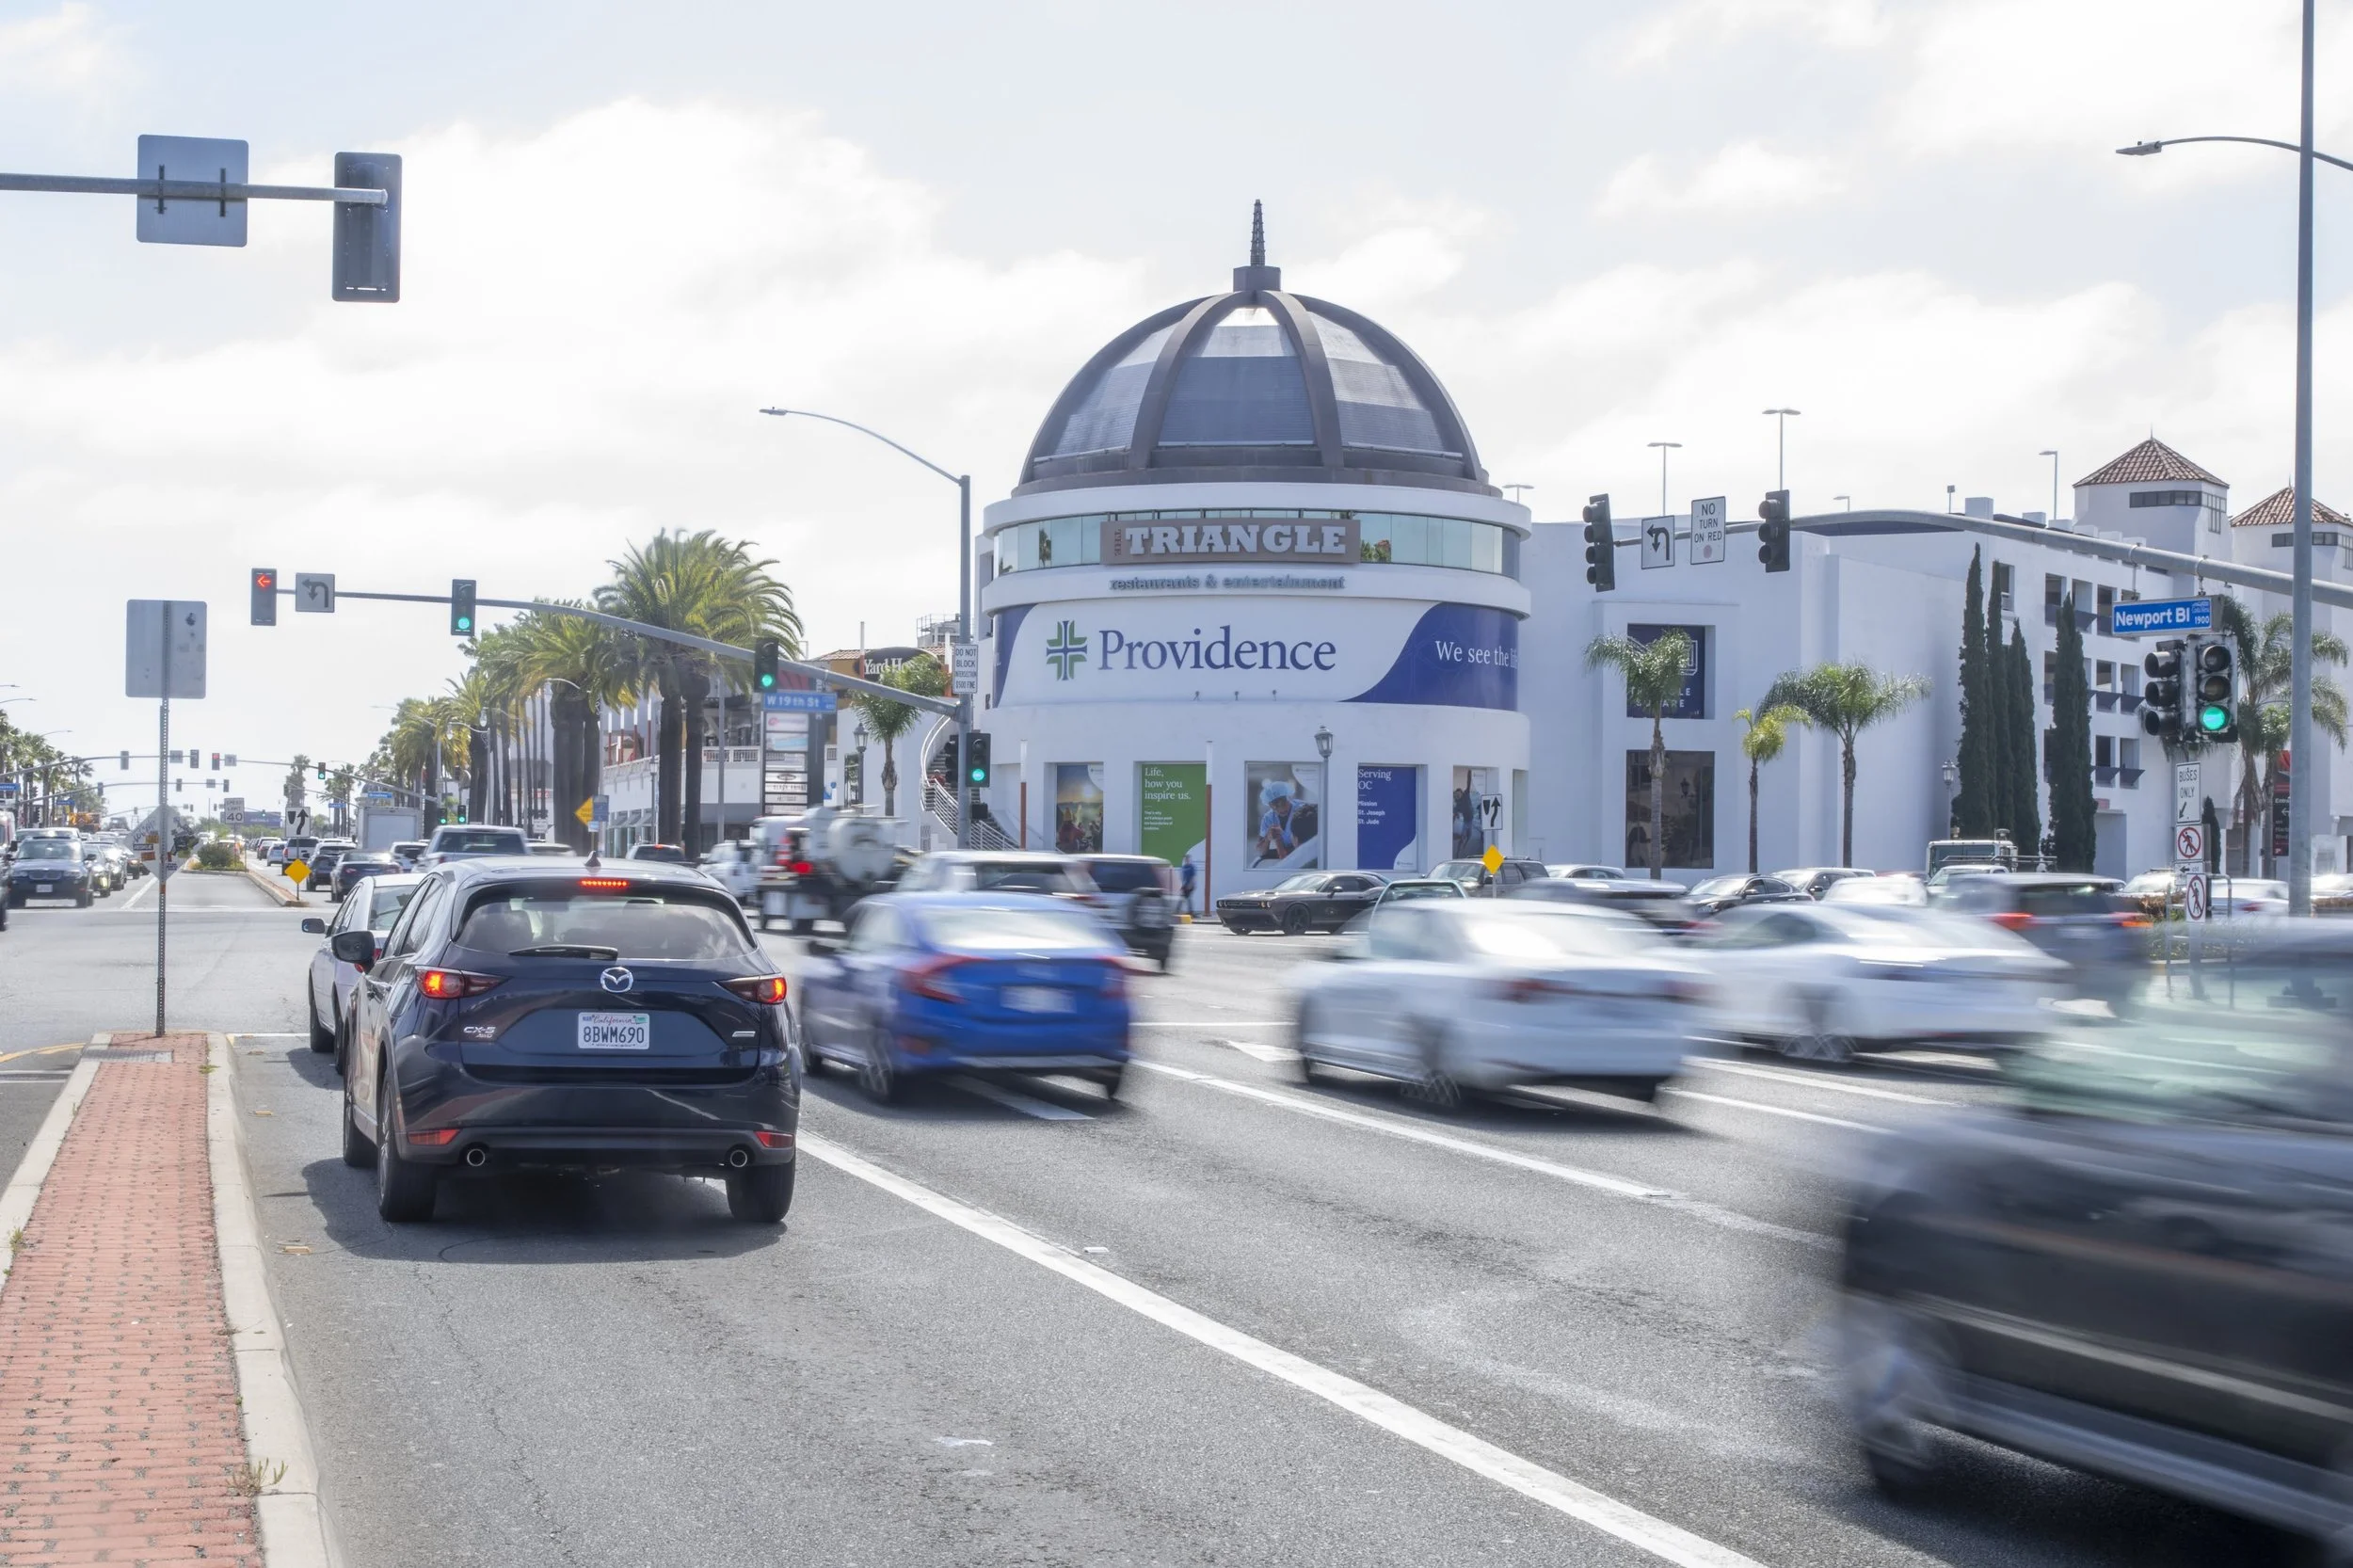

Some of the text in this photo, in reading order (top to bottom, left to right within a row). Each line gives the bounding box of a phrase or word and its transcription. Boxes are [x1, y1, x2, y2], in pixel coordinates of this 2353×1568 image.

[1702, 503, 1716, 516] NO
[1699, 518, 1719, 529] TURN
[1125, 524, 1346, 554] TRIANGLE
[1694, 531, 1722, 543] ON RED
[1110, 573, 1346, 591] restaurants & entertainment
[2116, 607, 2190, 629] Newport Bl
[2195, 616, 2210, 625] 1900
[965, 648, 976, 657] NOT
[1097, 625, 1337, 671] Providence
[1435, 640, 1463, 662] We
[1467, 648, 1491, 664] see
[1494, 645, 1509, 667] the
[865, 658, 888, 675] Yard
[955, 659, 976, 668] BLOCK
[967, 680, 976, 689] FINE
[767, 696, 776, 705] W
[807, 696, 820, 708] St
[1144, 767, 1164, 777] Life,
[1358, 769, 1392, 782] Serving
[2179, 768, 2198, 782] BUSES
[1144, 779, 1183, 791] how you
[1358, 780, 1373, 791] OC
[1144, 791, 1176, 802] inspire
[2180, 786, 2195, 798] ONLY
[226, 812, 243, 822] 40
[593, 1015, 635, 1026] California
[464, 1026, 497, 1034] CX-5
[583, 1026, 645, 1044] 8BWM690
